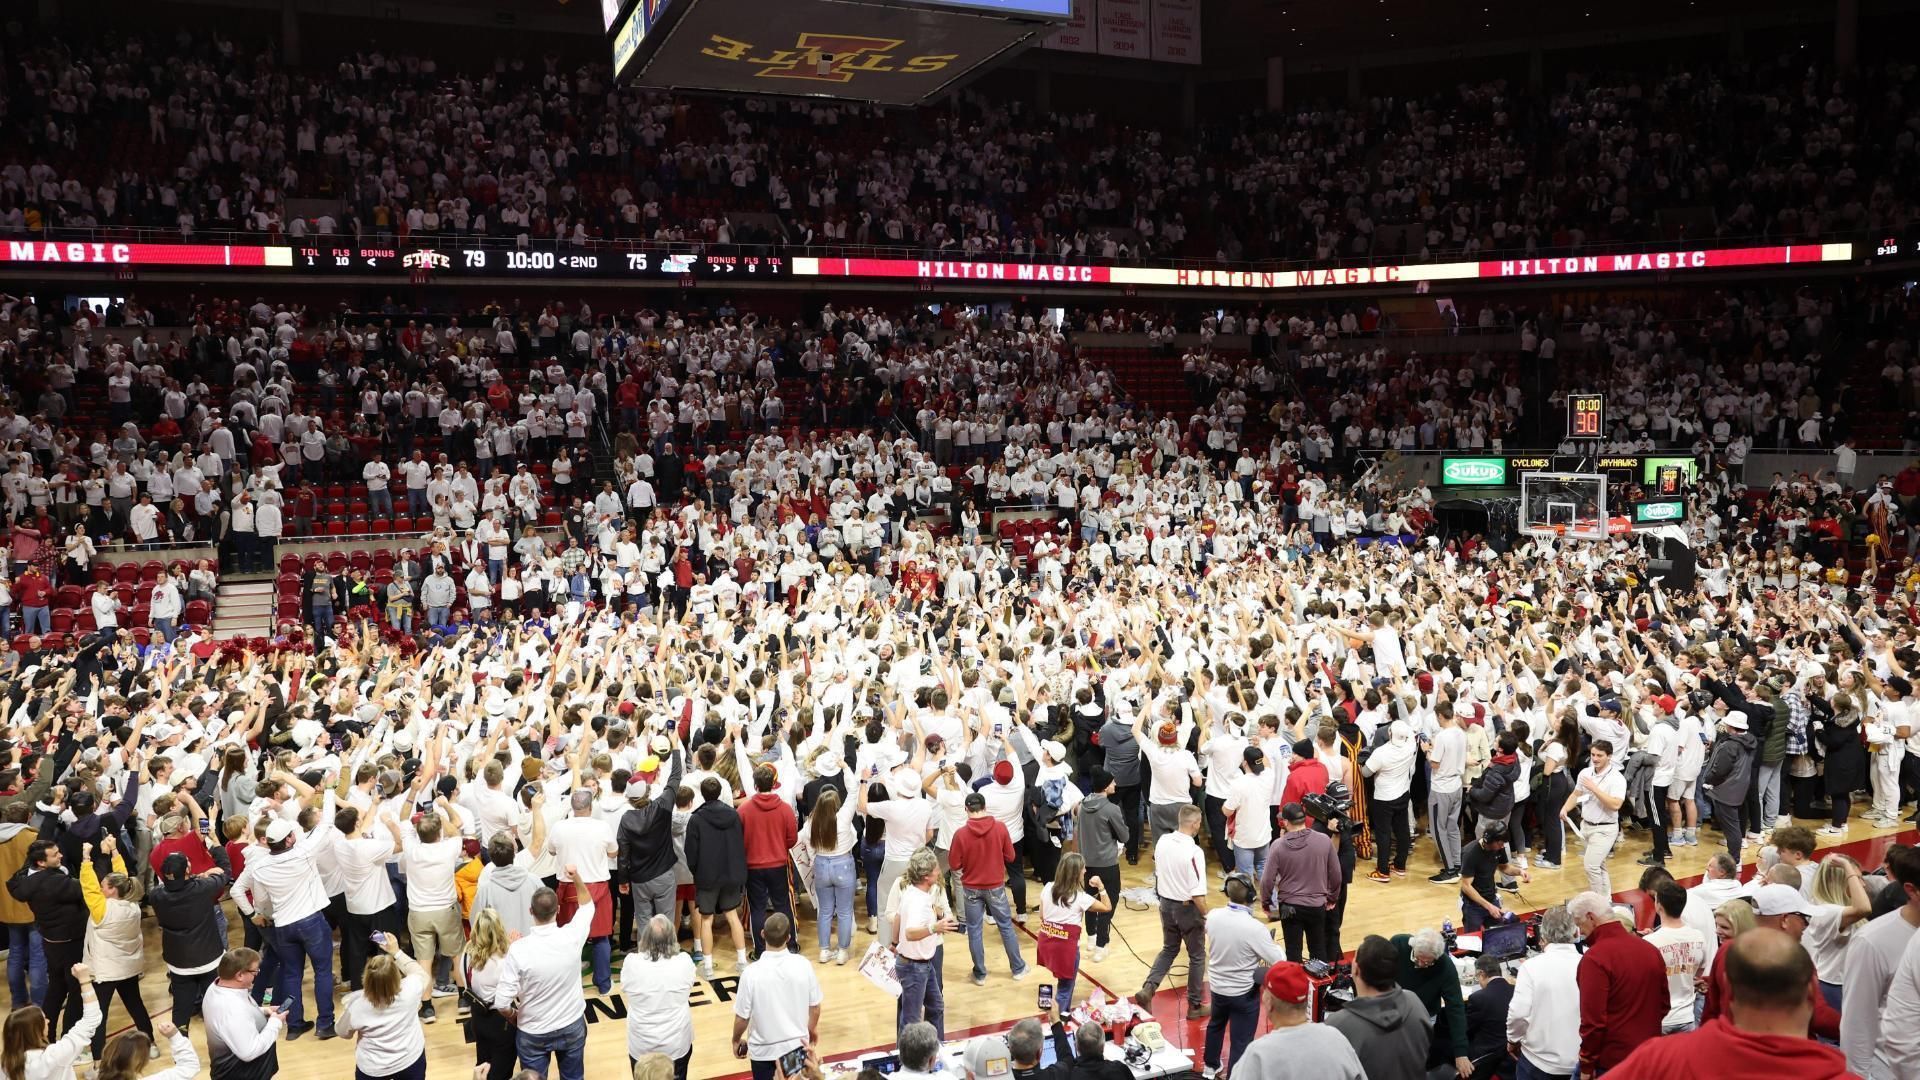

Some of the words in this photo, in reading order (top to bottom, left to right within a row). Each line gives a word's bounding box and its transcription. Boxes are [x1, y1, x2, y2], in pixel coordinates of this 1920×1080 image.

[1884, 238, 1895, 246] FT
[9, 241, 130, 263] MAGIC
[301, 248, 320, 257] TOL
[332, 248, 350, 257] FLS
[361, 249, 395, 258] BONUS
[1877, 245, 1898, 256] 9-18
[307, 256, 315, 266] 1
[335, 256, 350, 266] 10
[403, 249, 450, 269] STATE
[463, 250, 485, 267] 79
[506, 251, 554, 269] 10:00
[570, 256, 598, 268] 2ND
[626, 253, 648, 270] 75
[707, 256, 737, 264] BONUS
[744, 257, 759, 265] FLS
[1501, 256, 1598, 276] HILTON
[1614, 251, 1706, 271] MAGIC
[748, 264, 756, 273] 8
[918, 261, 1004, 279] HILTON
[1018, 264, 1092, 281] MAGIC
[1177, 269, 1274, 288] HILTON
[1296, 266, 1399, 286] MAGIC
[1576, 399, 1600, 411] 10:00
[1576, 412, 1598, 433] 30
[1512, 459, 1549, 467] CYCLONES
[1599, 458, 1638, 467] JAYHAWKS
[1450, 461, 1499, 478] Sukup
[1646, 504, 1674, 514] Sukup
